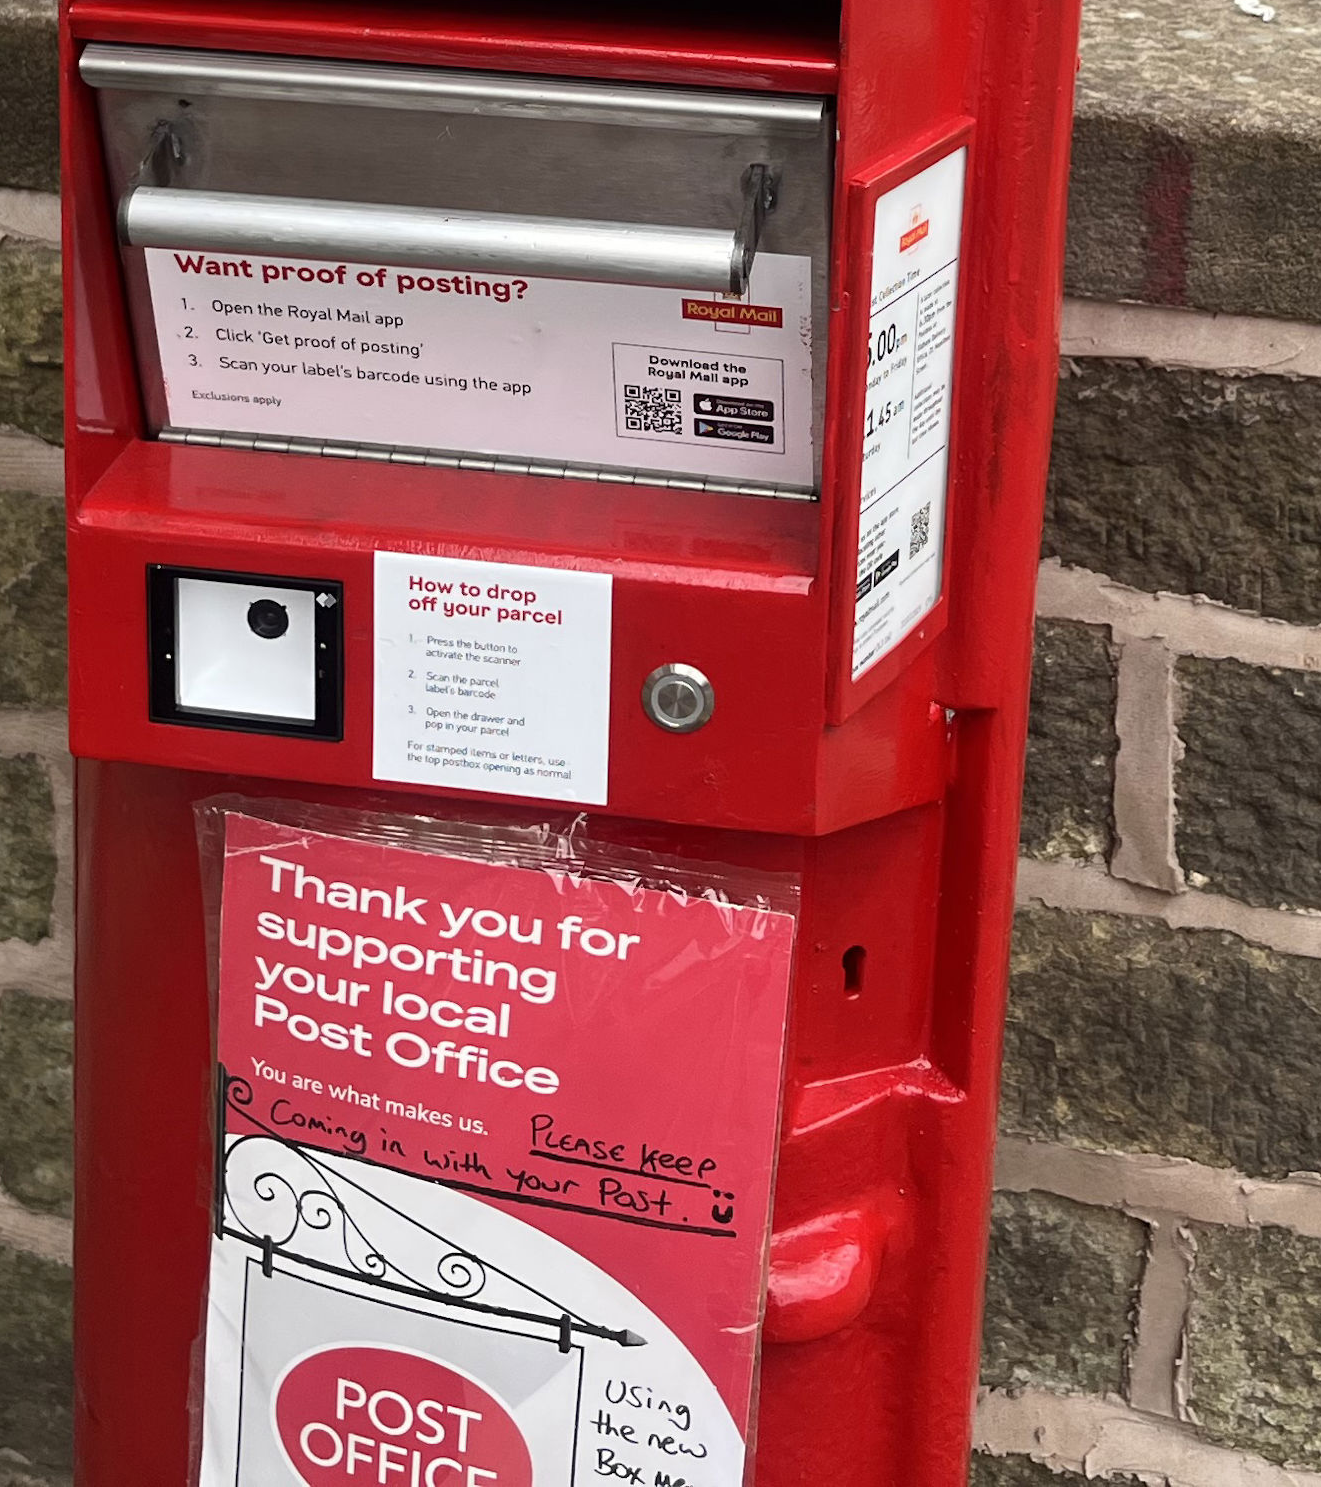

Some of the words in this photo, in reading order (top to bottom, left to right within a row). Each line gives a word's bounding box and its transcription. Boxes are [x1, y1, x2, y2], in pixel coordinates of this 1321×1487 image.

[174, 253, 253, 278] Want
[262, 260, 347, 284] proof
[357, 268, 387, 288] of
[397, 274, 528, 303] posting?
[181, 297, 195, 311] 1.
[212, 299, 253, 315] Open
[258, 303, 283, 317] the
[288, 305, 333, 322] Royal
[337, 308, 370, 325] Mail
[375, 314, 404, 329] app
[687, 302, 735, 319] Royal
[740, 307, 777, 322] Mail
[184, 326, 198, 339] 2.
[216, 328, 254, 343] Click
[294, 336, 336, 350] proof
[341, 337, 356, 351] of
[187, 354, 202, 367] 3.
[219, 356, 258, 372] Scan
[263, 362, 298, 375] your
[302, 362, 352, 379] label's
[357, 366, 420, 384] barcode
[425, 374, 468, 391] using
[472, 377, 498, 391] the
[502, 383, 532, 396] app
[648, 367, 686, 380] Royal
[690, 371, 719, 383] Mail
[722, 376, 749, 388] app
[649, 355, 719, 371] Download
[723, 363, 747, 374] the
[191, 390, 250, 403] Exclusions
[253, 396, 282, 407] apply
[716, 404, 738, 415] App
[740, 406, 769, 417] Store
[866, 401, 892, 437] 1.45
[717, 428, 749, 439] Google
[751, 431, 769, 441] Play
[408, 575, 453, 594] How
[460, 582, 481, 597] to
[486, 584, 537, 606] drop
[408, 596, 438, 611] off
[443, 601, 491, 618] your
[497, 607, 562, 625] parcel
[426, 635, 455, 648] Press
[456, 639, 472, 650] the
[474, 640, 506, 653] button
[507, 644, 518, 654] to
[426, 649, 464, 661] activate
[465, 652, 482, 663] the
[483, 655, 522, 667] scanner
[426, 671, 450, 682] Scan
[452, 674, 468, 685] the
[469, 677, 500, 688] parcel
[457, 688, 496, 700] barcode
[425, 720, 443, 731] pop
[445, 721, 454, 730] in
[456, 724, 477, 734] your
[480, 726, 510, 737] parcel
[426, 706, 451, 719] Open
[453, 709, 469, 720] the
[470, 712, 504, 724] drawer
[507, 717, 526, 727] and
[407, 740, 423, 751] For
[426, 743, 468, 757] stamped
[470, 748, 497, 759] items
[499, 752, 509, 761] or
[548, 758, 566, 768] use
[407, 752, 423, 763] the
[424, 755, 441, 766] top
[442, 758, 481, 770] postbox
[483, 762, 521, 776] opening
[523, 766, 535, 776] as
[537, 768, 572, 780] normal
[259, 854, 428, 926] Thank
[438, 902, 543, 946] you
[557, 916, 641, 961] for
[256, 911, 557, 1004] supporting
[254, 956, 370, 1007] your
[382, 981, 511, 1039] local
[254, 994, 373, 1059] Post
[385, 1031, 560, 1096] Office
[251, 1056, 286, 1085] You
[292, 1074, 323, 1095] are
[328, 1084, 380, 1111] what
[385, 1099, 453, 1128] makes
[458, 1116, 489, 1136] us.
[270, 1099, 367, 1155] Coming
[380, 1127, 407, 1157] in
[423, 1149, 493, 1181] with
[336, 1377, 483, 1453] POST
[590, 1409, 639, 1445] the
[648, 1433, 708, 1459] new
[594, 1448, 646, 1485] Box
